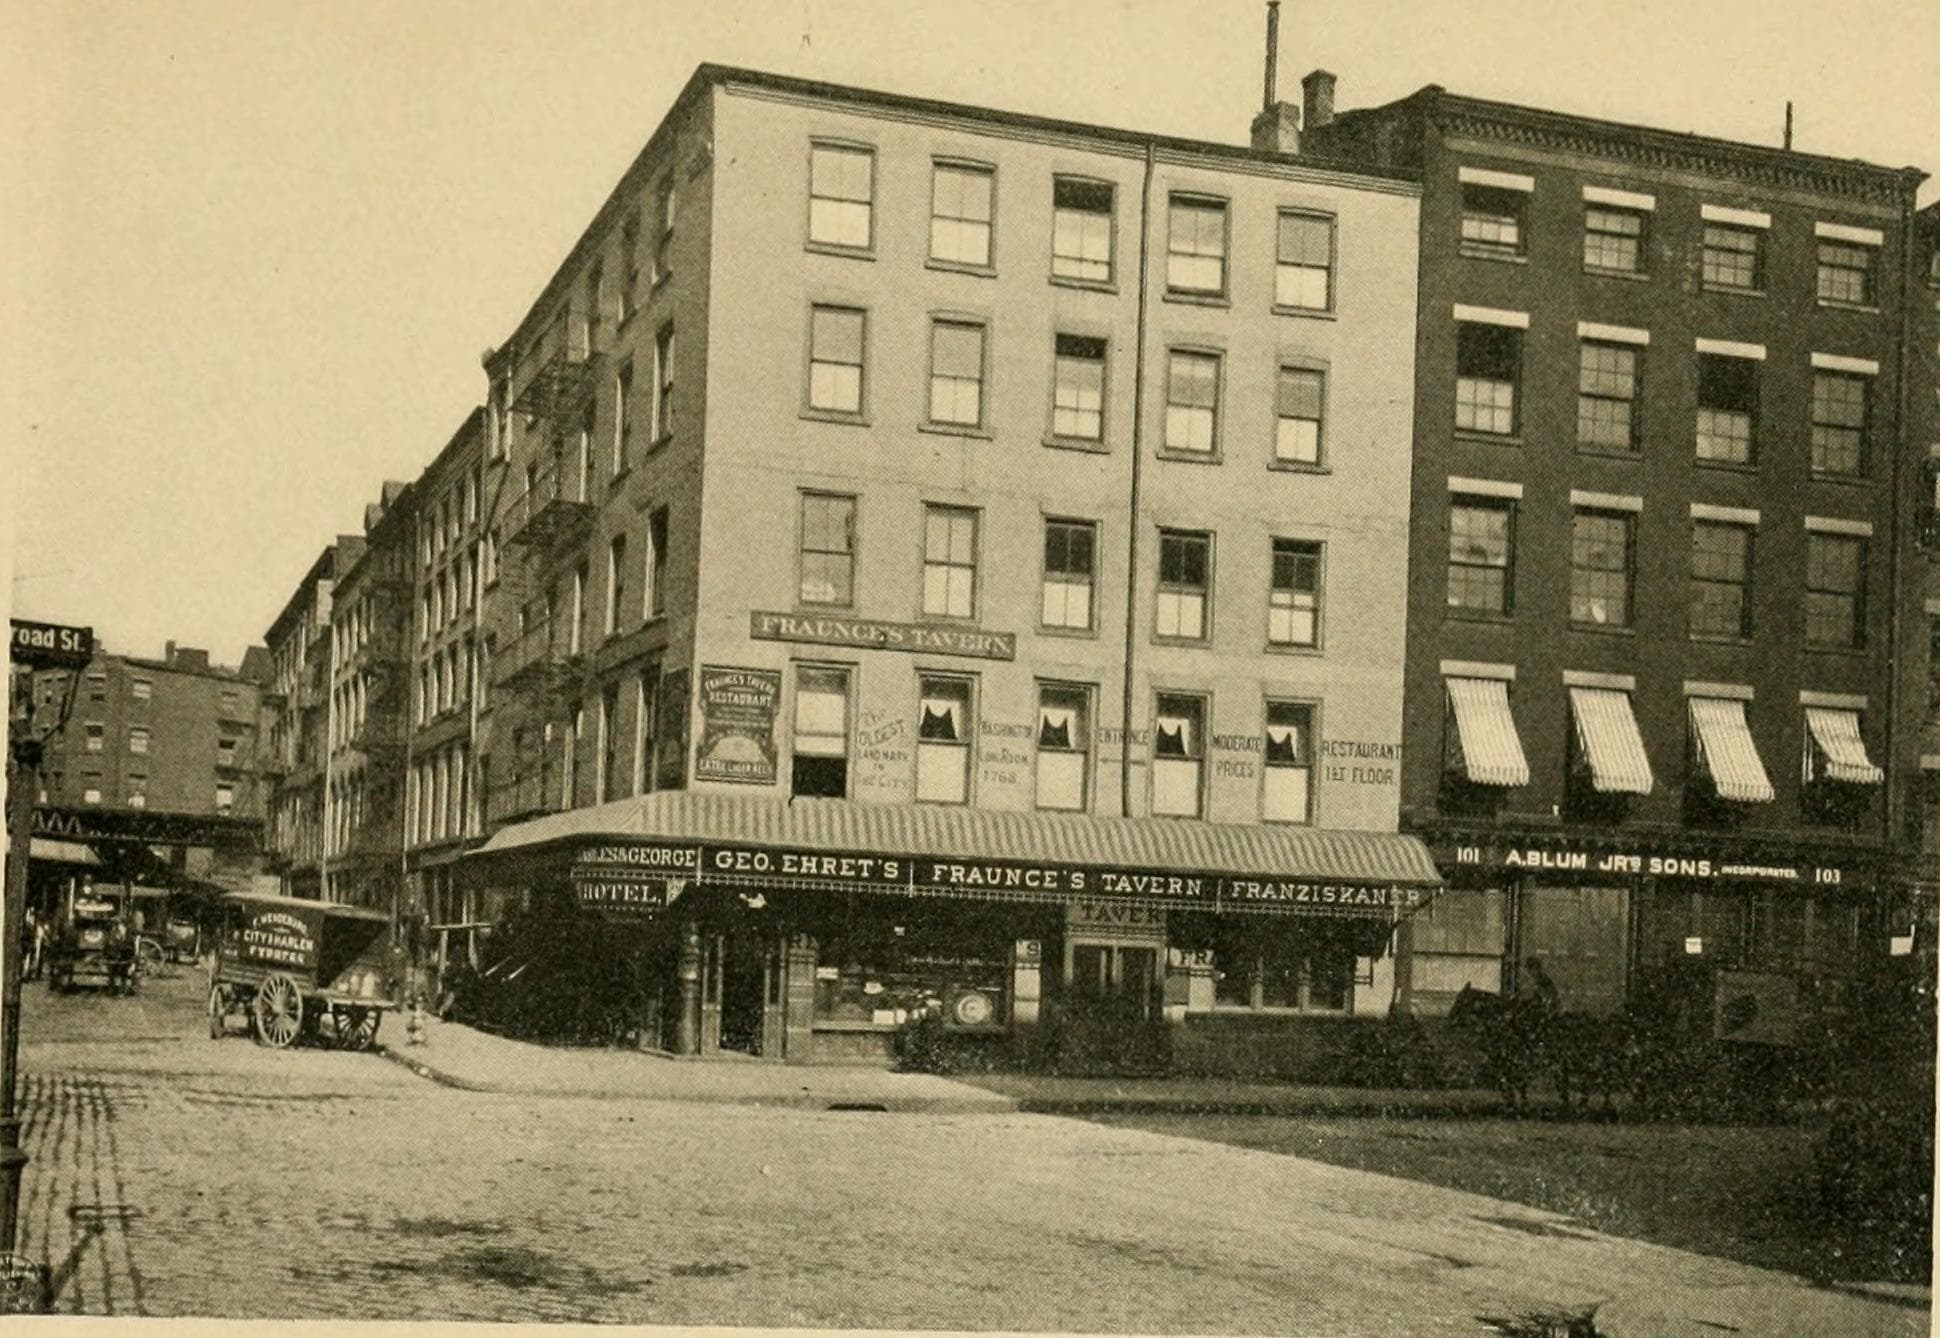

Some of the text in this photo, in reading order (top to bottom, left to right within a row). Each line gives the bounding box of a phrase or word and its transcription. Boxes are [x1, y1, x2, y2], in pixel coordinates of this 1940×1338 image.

[911, 629, 1010, 651] TAVERN
[708, 690, 772, 708] RESTAURANT
[1322, 740, 1403, 760] RESTAURANT
[715, 850, 899, 879] GEO. EHRET'S
[1457, 847, 1479, 864] 101
[1816, 868, 1841, 884] 103
[932, 864, 1202, 896] FRAUNCE'S TAVERN
[243, 929, 268, 944] CITY
